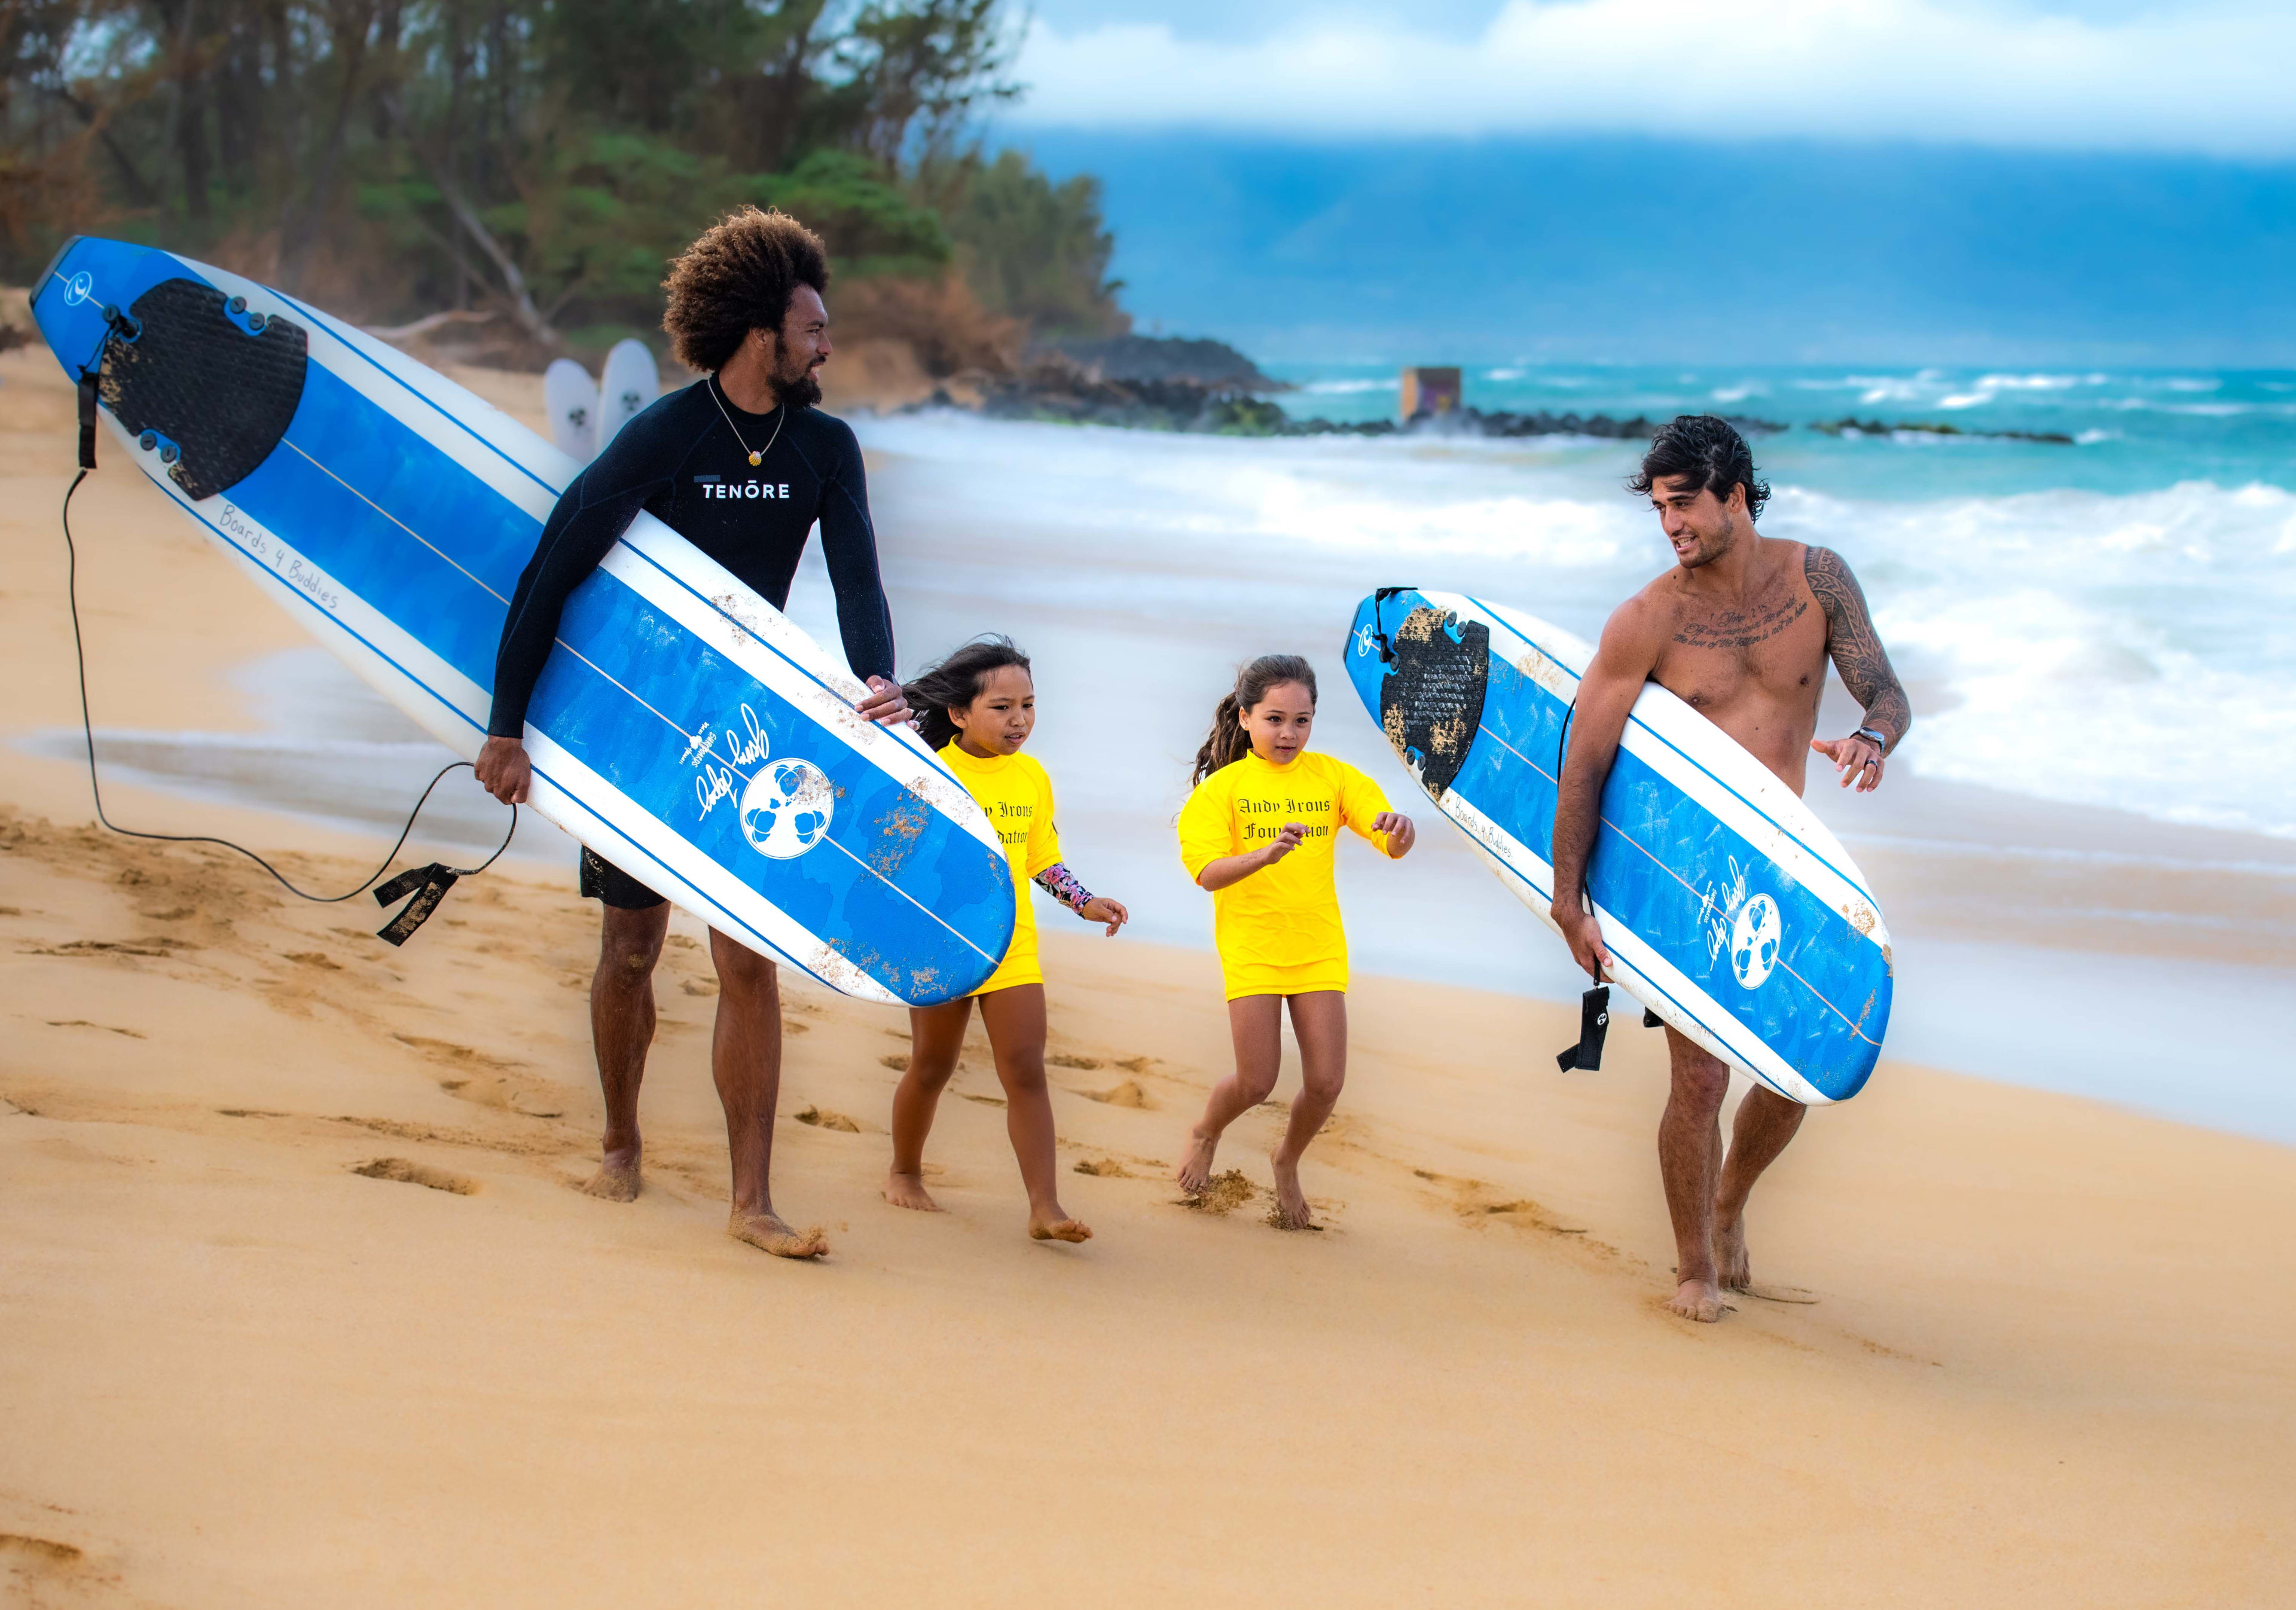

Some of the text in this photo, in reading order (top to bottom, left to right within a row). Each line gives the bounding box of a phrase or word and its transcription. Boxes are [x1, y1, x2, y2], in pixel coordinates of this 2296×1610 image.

[703, 480, 789, 499] TENŌRE
[219, 504, 339, 609] Boards 4 Buddies
[691, 732, 717, 768] SURFBOARDS
[997, 802, 1033, 817] Irons
[1237, 798, 1331, 815] Andy Irons
[1455, 796, 1512, 858] Boards 4 Buddies
